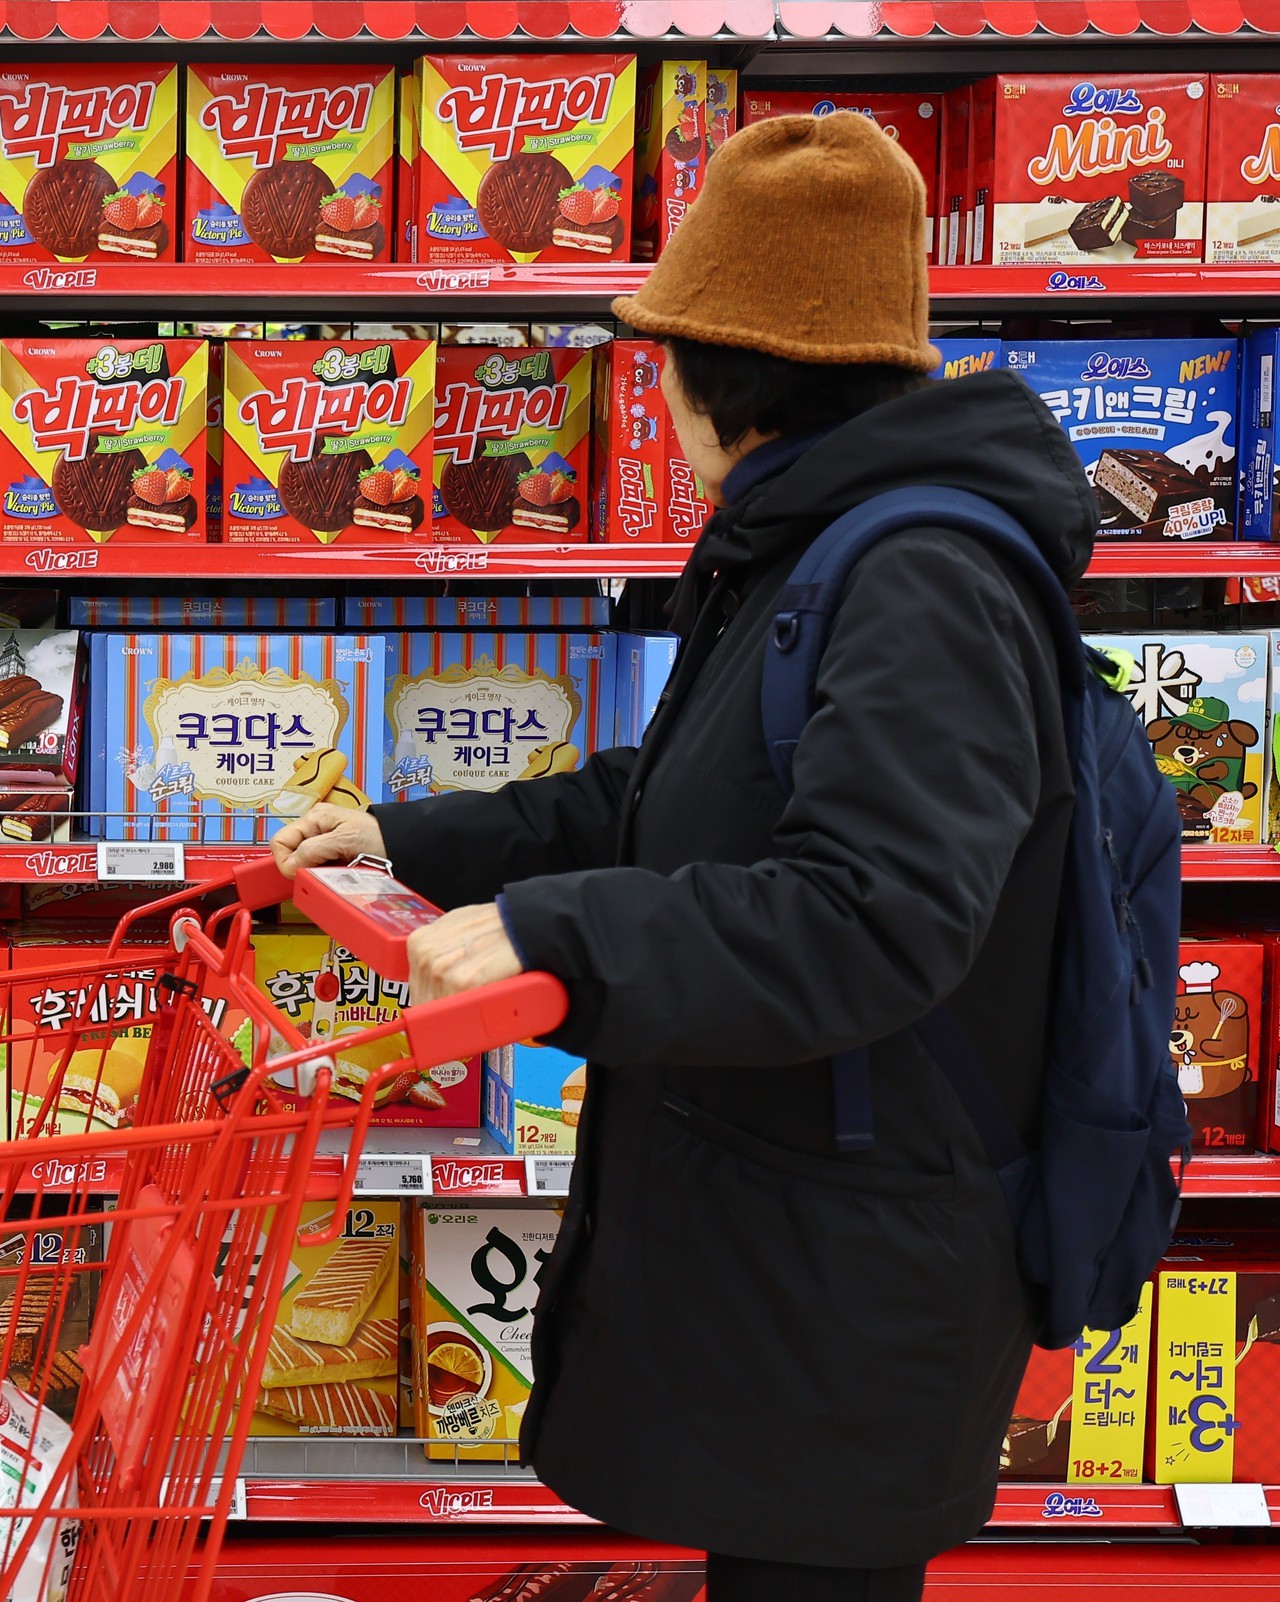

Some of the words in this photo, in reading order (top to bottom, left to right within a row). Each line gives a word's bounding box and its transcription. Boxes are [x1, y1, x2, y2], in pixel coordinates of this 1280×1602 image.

[1, 73, 30, 82] CROWN
[221, 73, 248, 81] CROWN
[1064, 82, 1143, 115] 오예스
[199, 82, 375, 169] 빅파이
[436, 72, 617, 162] 빅파이
[73, 144, 91, 156] 딸기
[92, 139, 135, 152] Strawberry
[1028, 107, 1172, 184] Mini
[1167, 159, 1185, 169] 미니
[8, 228, 25, 240] Pie
[23, 269, 97, 290] VICPIE
[417, 269, 491, 290] VICPIE
[1046, 271, 1106, 292] 오예스
[944, 351, 995, 379] NEW!
[1081, 352, 1152, 380] 오예스
[1179, 350, 1232, 384] NEW!
[12, 375, 183, 461] 빅파이
[240, 376, 413, 463] 빅파이
[1076, 425, 1116, 437] COOKIE
[1122, 425, 1159, 437] CREAM
[1168, 499, 1213, 519] 크림중량
[1163, 518, 1199, 537] 40%
[1199, 510, 1226, 528] UP!
[25, 549, 99, 571] VICPIE
[458, 601, 497, 612] 쿠크다스
[121, 646, 153, 656] CROWN
[176, 712, 316, 750] 쿠크다스
[416, 708, 549, 743] 쿠크다스
[38, 732, 59, 748] 10
[35, 747, 58, 755] CAKES
[453, 749, 510, 767] 케이크
[216, 753, 276, 774] 케이크
[149, 775, 195, 801] 순크림
[216, 778, 247, 786] COUQUE
[250, 778, 275, 787] CAKE
[1211, 828, 1254, 842] 12자루
[153, 861, 174, 870] 2,980
[517, 1126, 557, 1143] 12개입
[1202, 1127, 1246, 1146] 12개입
[402, 1174, 422, 1184] 5,760
[431, 1162, 504, 1191] VICPIE
[442, 1213, 479, 1224] 오리온
[1167, 1278, 1228, 1295] 27+3개입
[1170, 1341, 1223, 1357] 드립니다
[446, 1397, 480, 1412] 덴마크산
[436, 1408, 481, 1432] 까망베르
[480, 1402, 501, 1418] 치즈
[1083, 1412, 1135, 1427] 드립니다
[1073, 1460, 1138, 1479] 18+2개입
[1042, 1492, 1104, 1518] 오예스
